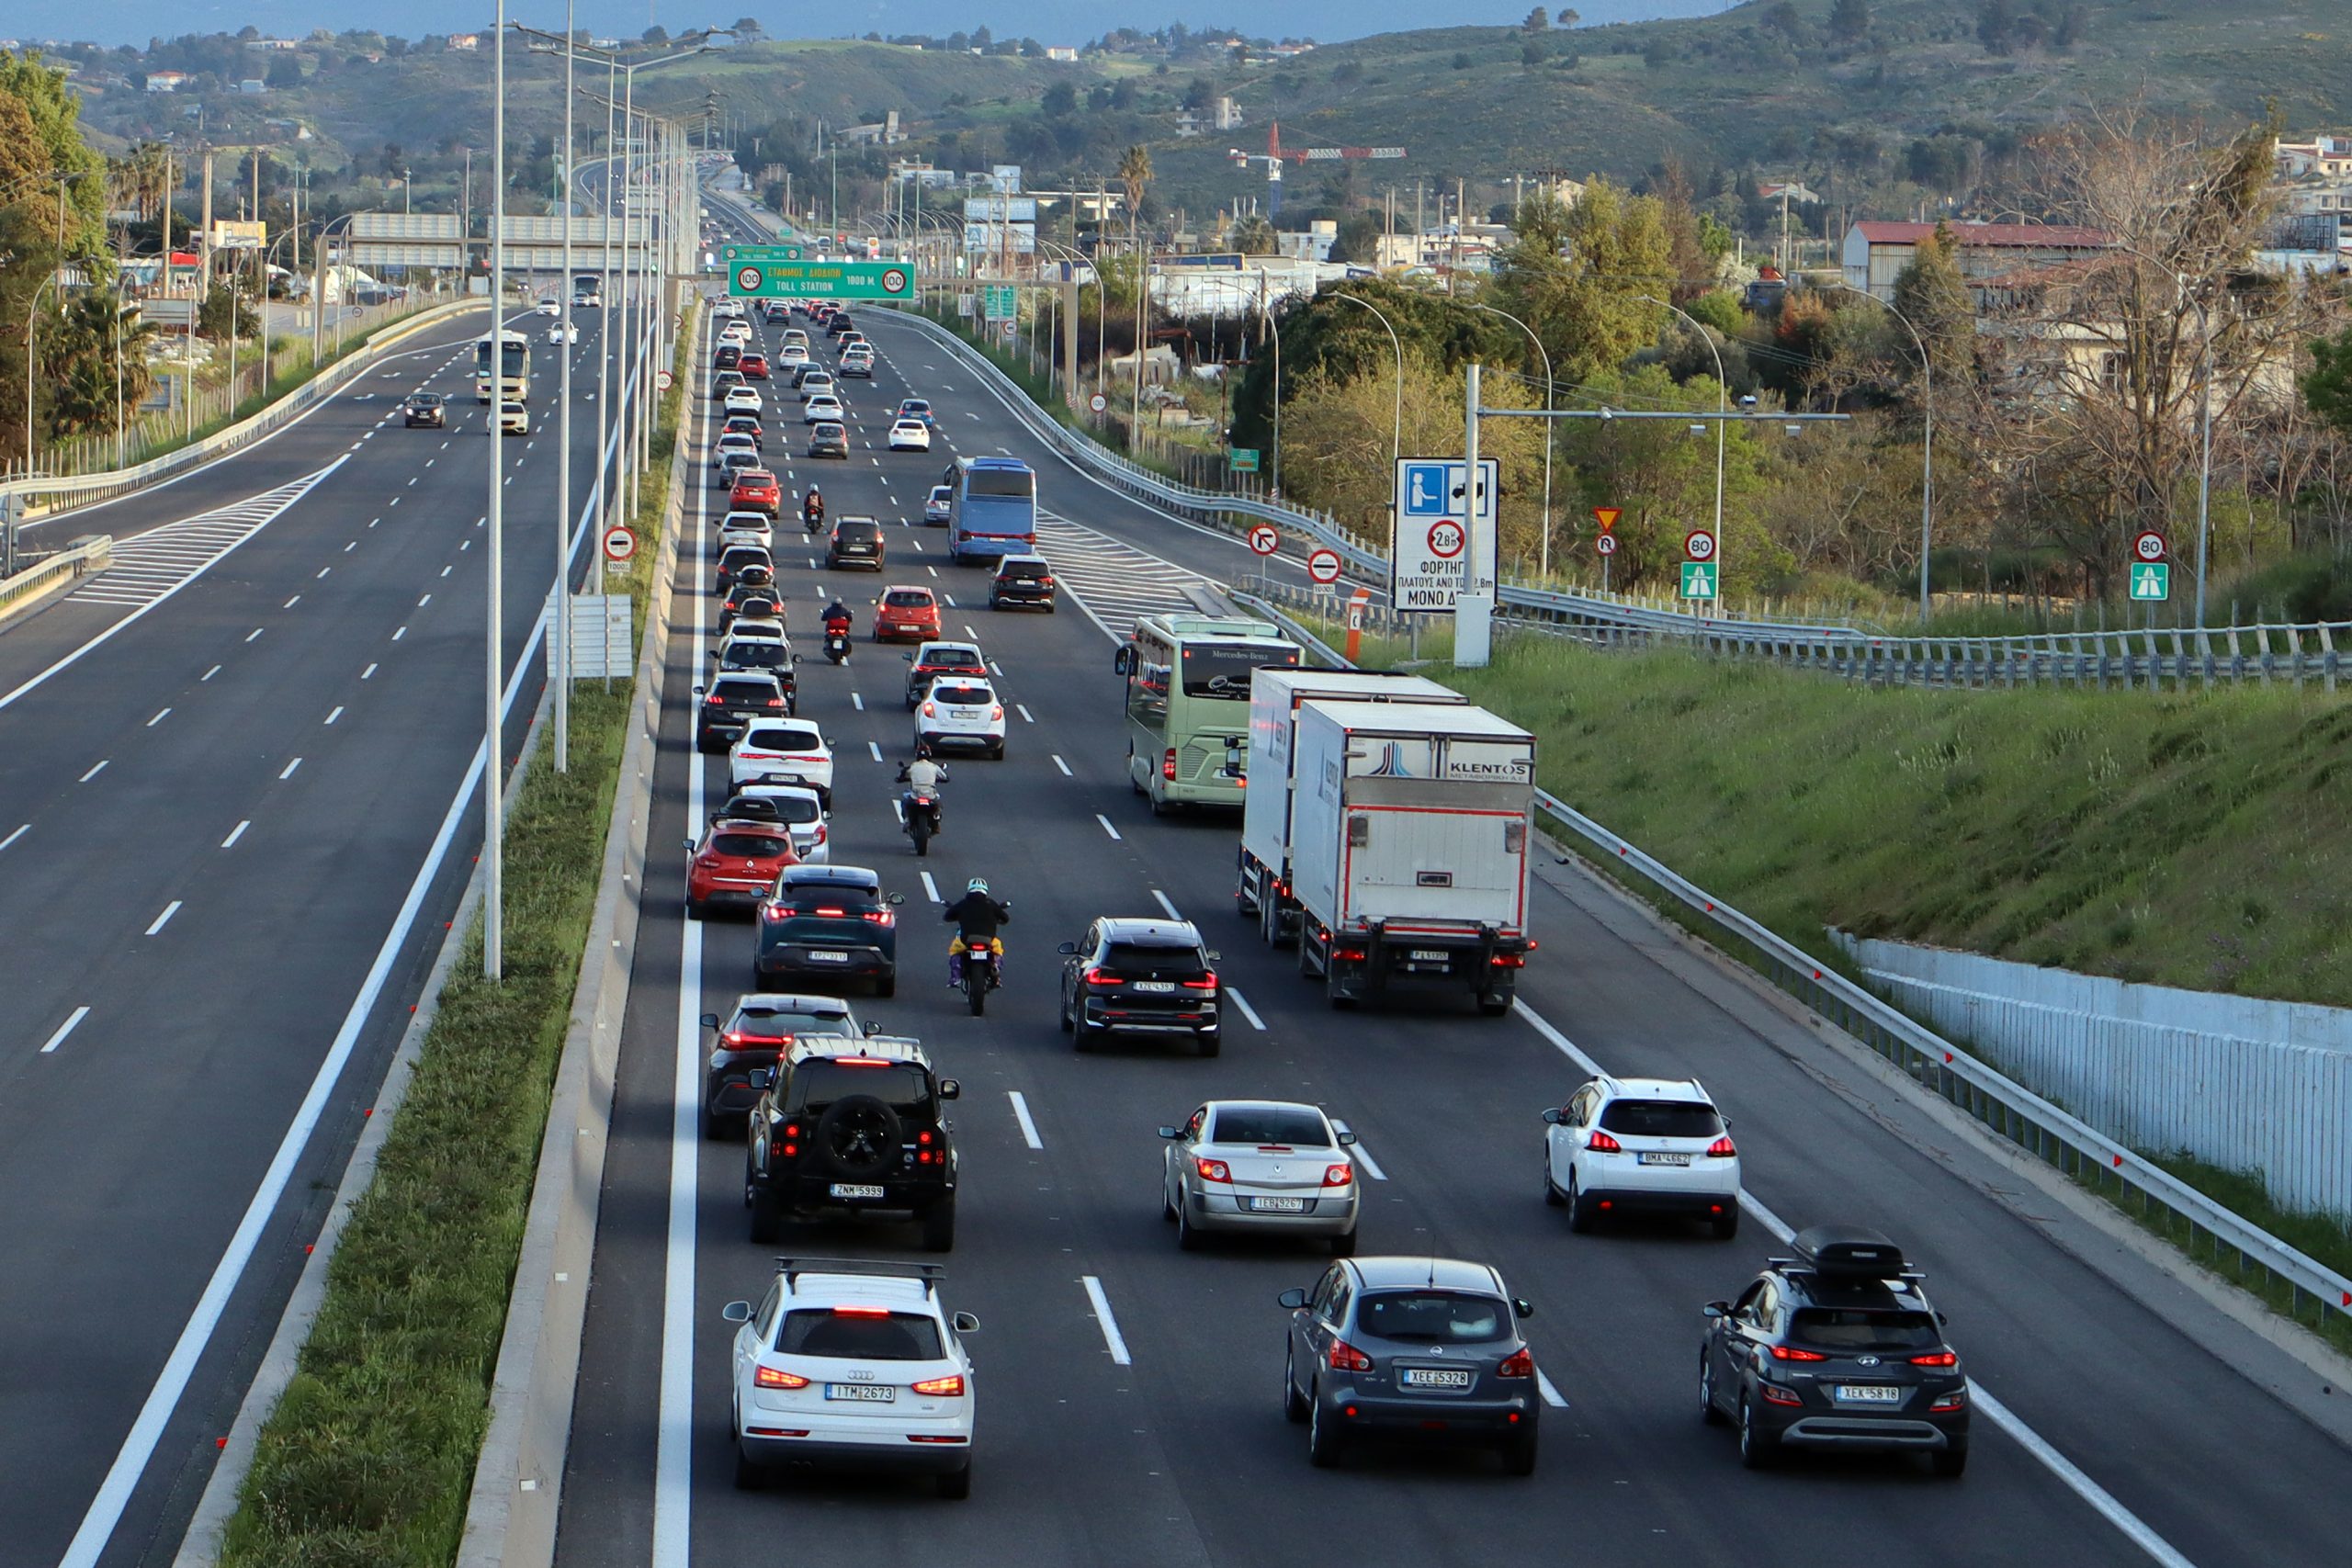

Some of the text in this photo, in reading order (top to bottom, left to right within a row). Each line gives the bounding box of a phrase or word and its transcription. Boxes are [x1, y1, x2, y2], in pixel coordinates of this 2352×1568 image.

[741, 274, 758, 284] 100
[846, 275, 865, 286] 1000
[886, 276, 901, 286] 100
[776, 280, 833, 292] TOLL STATION
[1691, 540, 1709, 552] 80
[2141, 541, 2159, 553] 80
[1420, 560, 1464, 574] ΦΟΡΤΗΓ
[1398, 577, 1434, 588] ΠΛΑΤΟΥΣ
[1408, 590, 1444, 605] ΜΟΝΟ
[1212, 649, 1269, 660] Mercedes-Benz
[1451, 762, 1526, 775] KLENTOS
[1438, 1371, 1466, 1383] 5328
[864, 1387, 892, 1399] 2673
